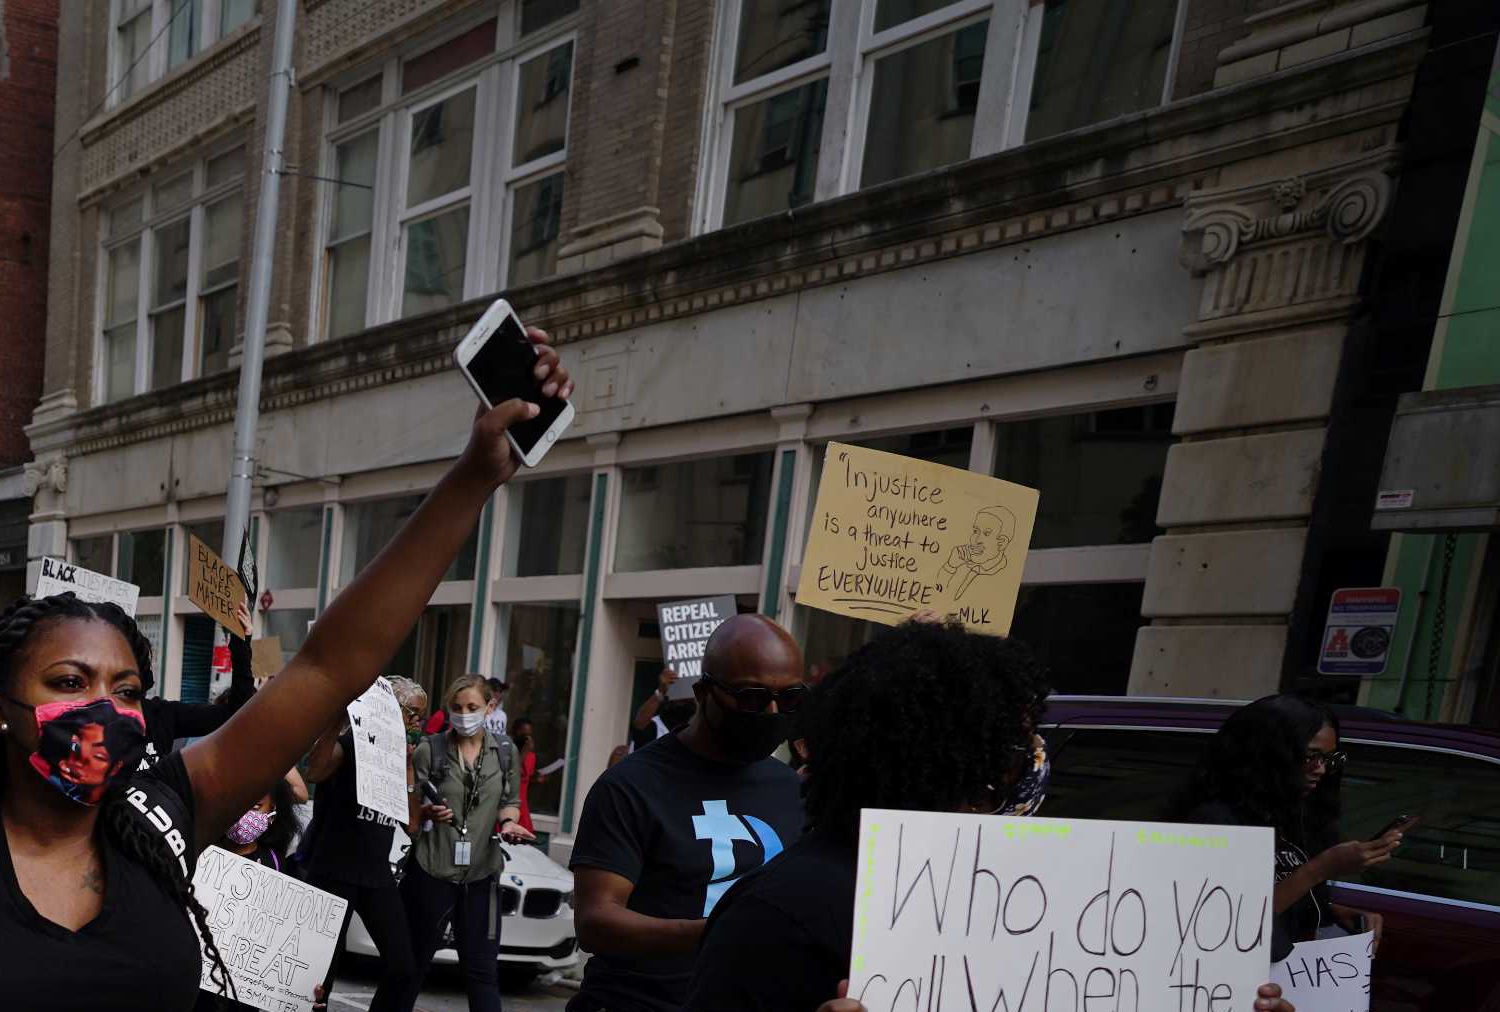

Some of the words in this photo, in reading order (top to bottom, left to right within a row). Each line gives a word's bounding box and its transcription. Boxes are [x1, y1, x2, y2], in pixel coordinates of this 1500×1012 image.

[823, 511, 840, 534] is
[848, 525, 857, 541] a
[863, 523, 915, 550] threat
[920, 538, 940, 554] to
[867, 504, 948, 531] anywhere
[42, 558, 77, 584] BLACK
[198, 543, 234, 586] BLACK
[196, 581, 235, 618] MATTER
[662, 602, 719, 623] REPEAL
[668, 640, 708, 660] ARRE
[889, 823, 1048, 941] Who
[1076, 831, 1147, 956] do
[1169, 877, 1267, 977] you
[208, 892, 237, 930] IS
[238, 904, 284, 946] NOT
[279, 925, 301, 956] A
[210, 926, 310, 987] THREAT
[1286, 952, 1359, 989] HAS
